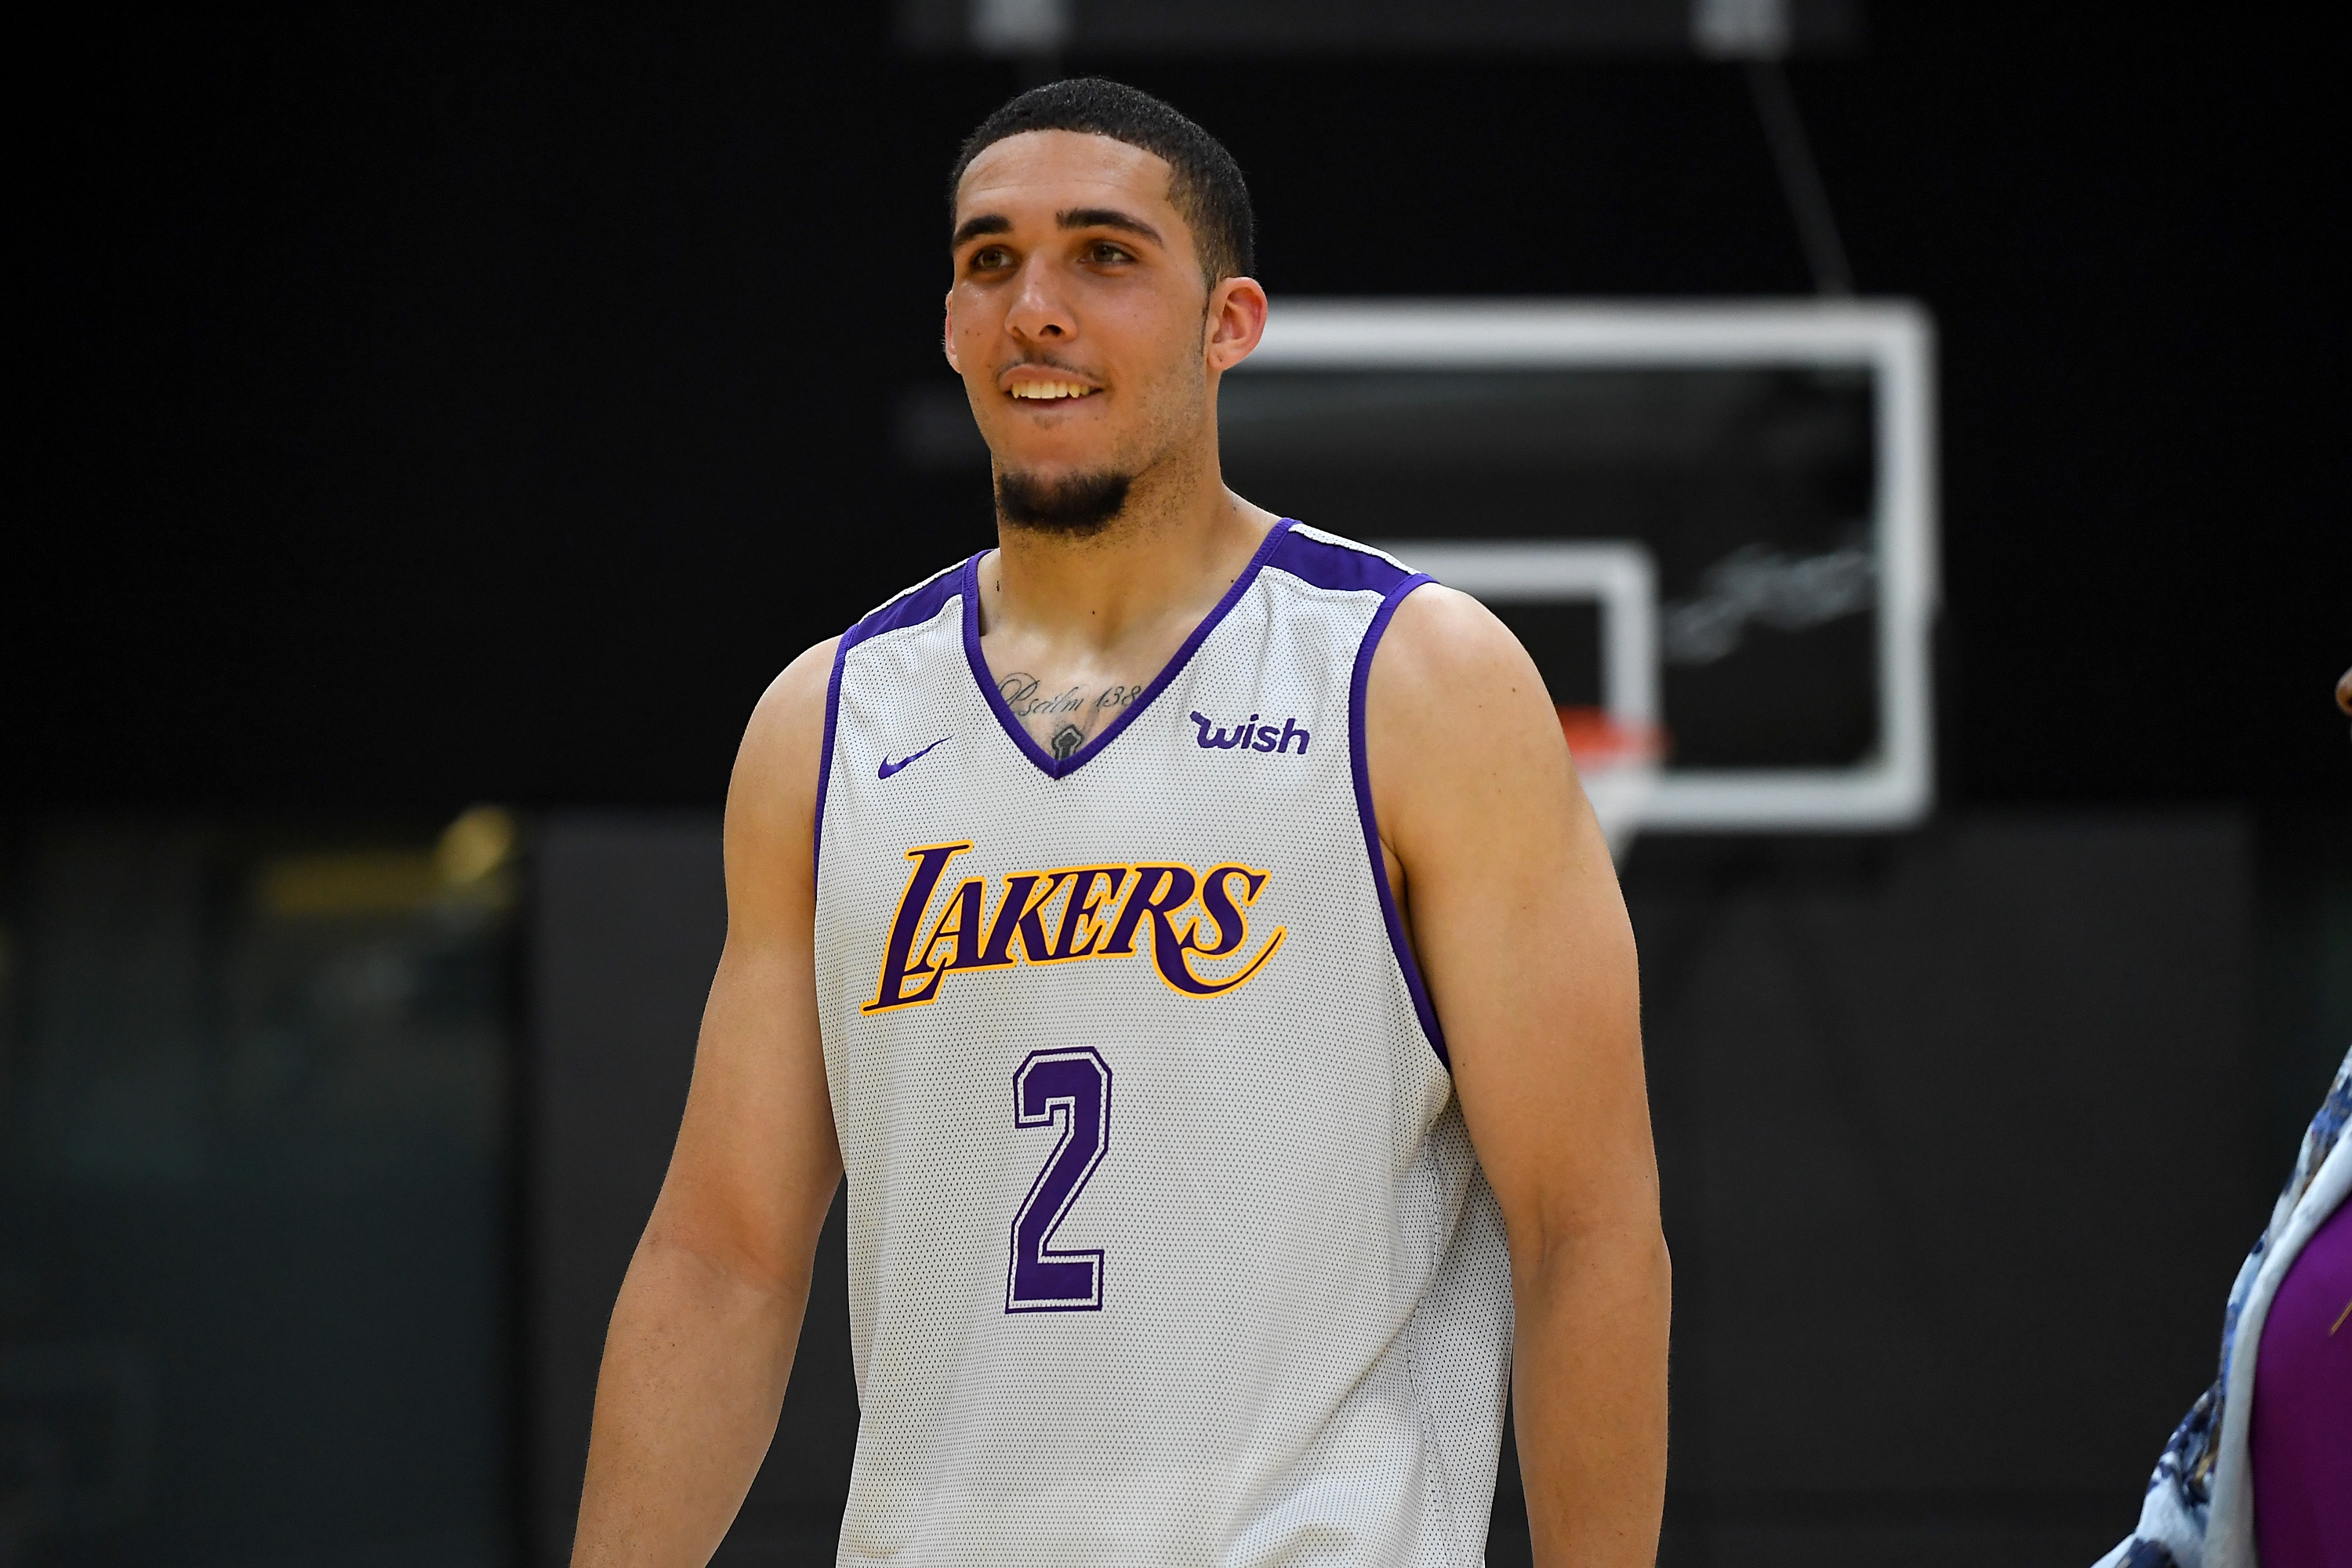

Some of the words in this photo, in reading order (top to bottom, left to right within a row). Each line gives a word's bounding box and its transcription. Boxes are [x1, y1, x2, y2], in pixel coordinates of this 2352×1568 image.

[997, 672, 1084, 717] Psalm
[1189, 710, 1310, 755] wish
[859, 840, 1287, 1015] LAKERS
[1005, 1047, 1112, 1314] 2
